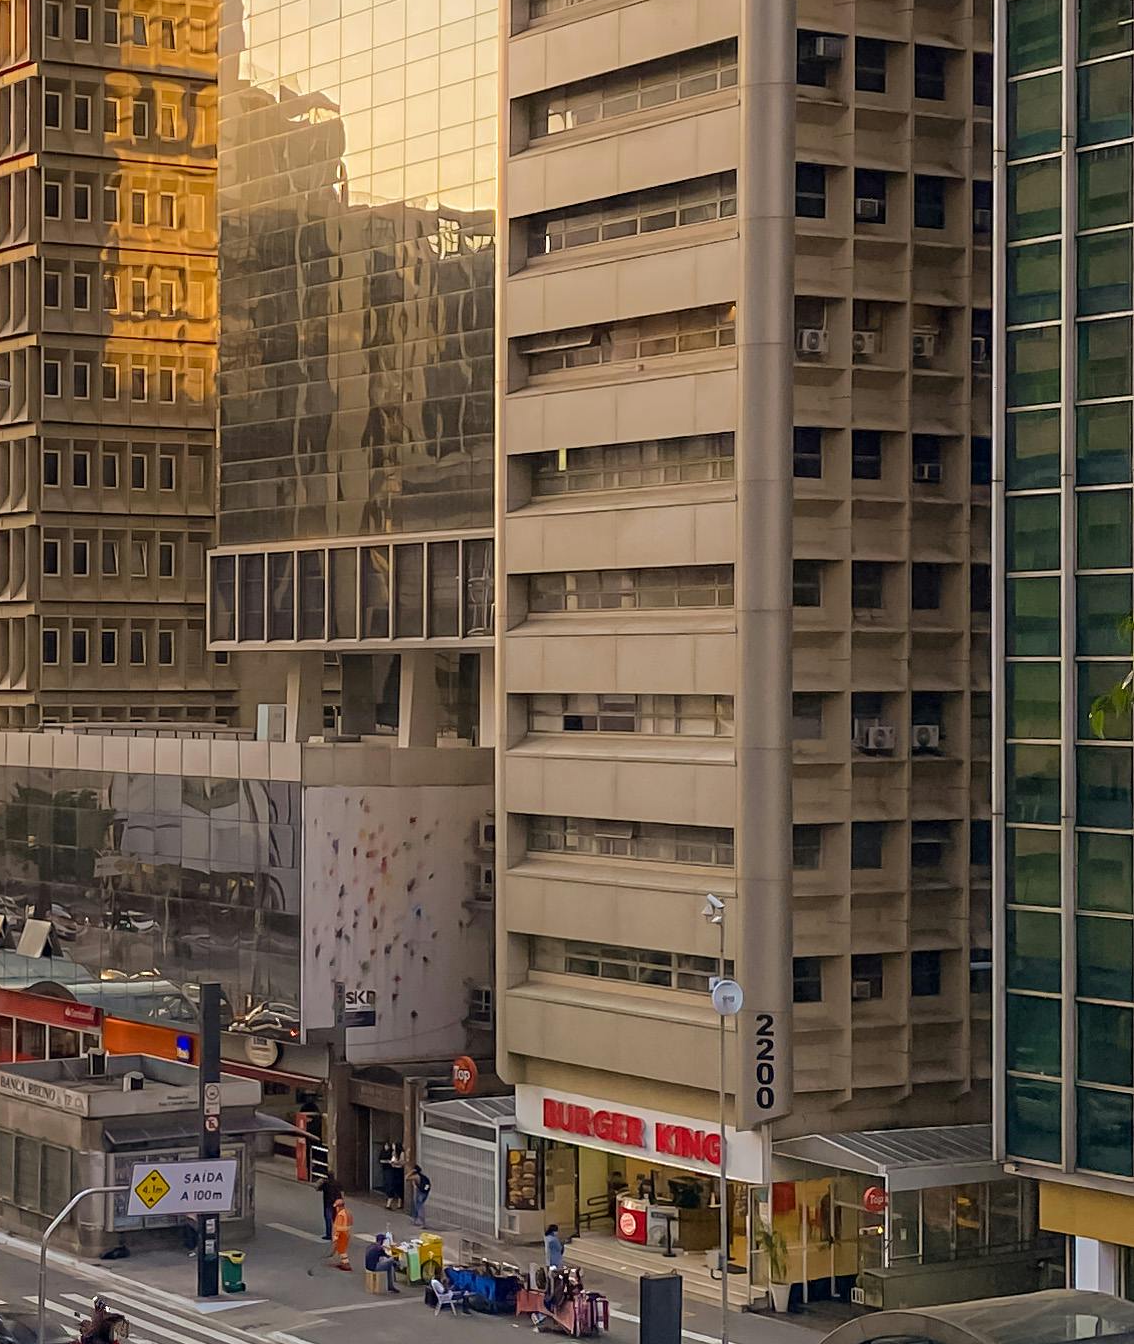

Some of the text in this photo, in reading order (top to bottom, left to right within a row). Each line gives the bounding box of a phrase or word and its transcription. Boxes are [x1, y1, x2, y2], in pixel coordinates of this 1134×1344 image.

[755, 1014, 774, 1109] 2200
[453, 1065, 471, 1083] Top
[0, 1075, 26, 1093] BANCA
[543, 1098, 722, 1165] BURGER KING
[180, 1190, 222, 1200] A 100m
